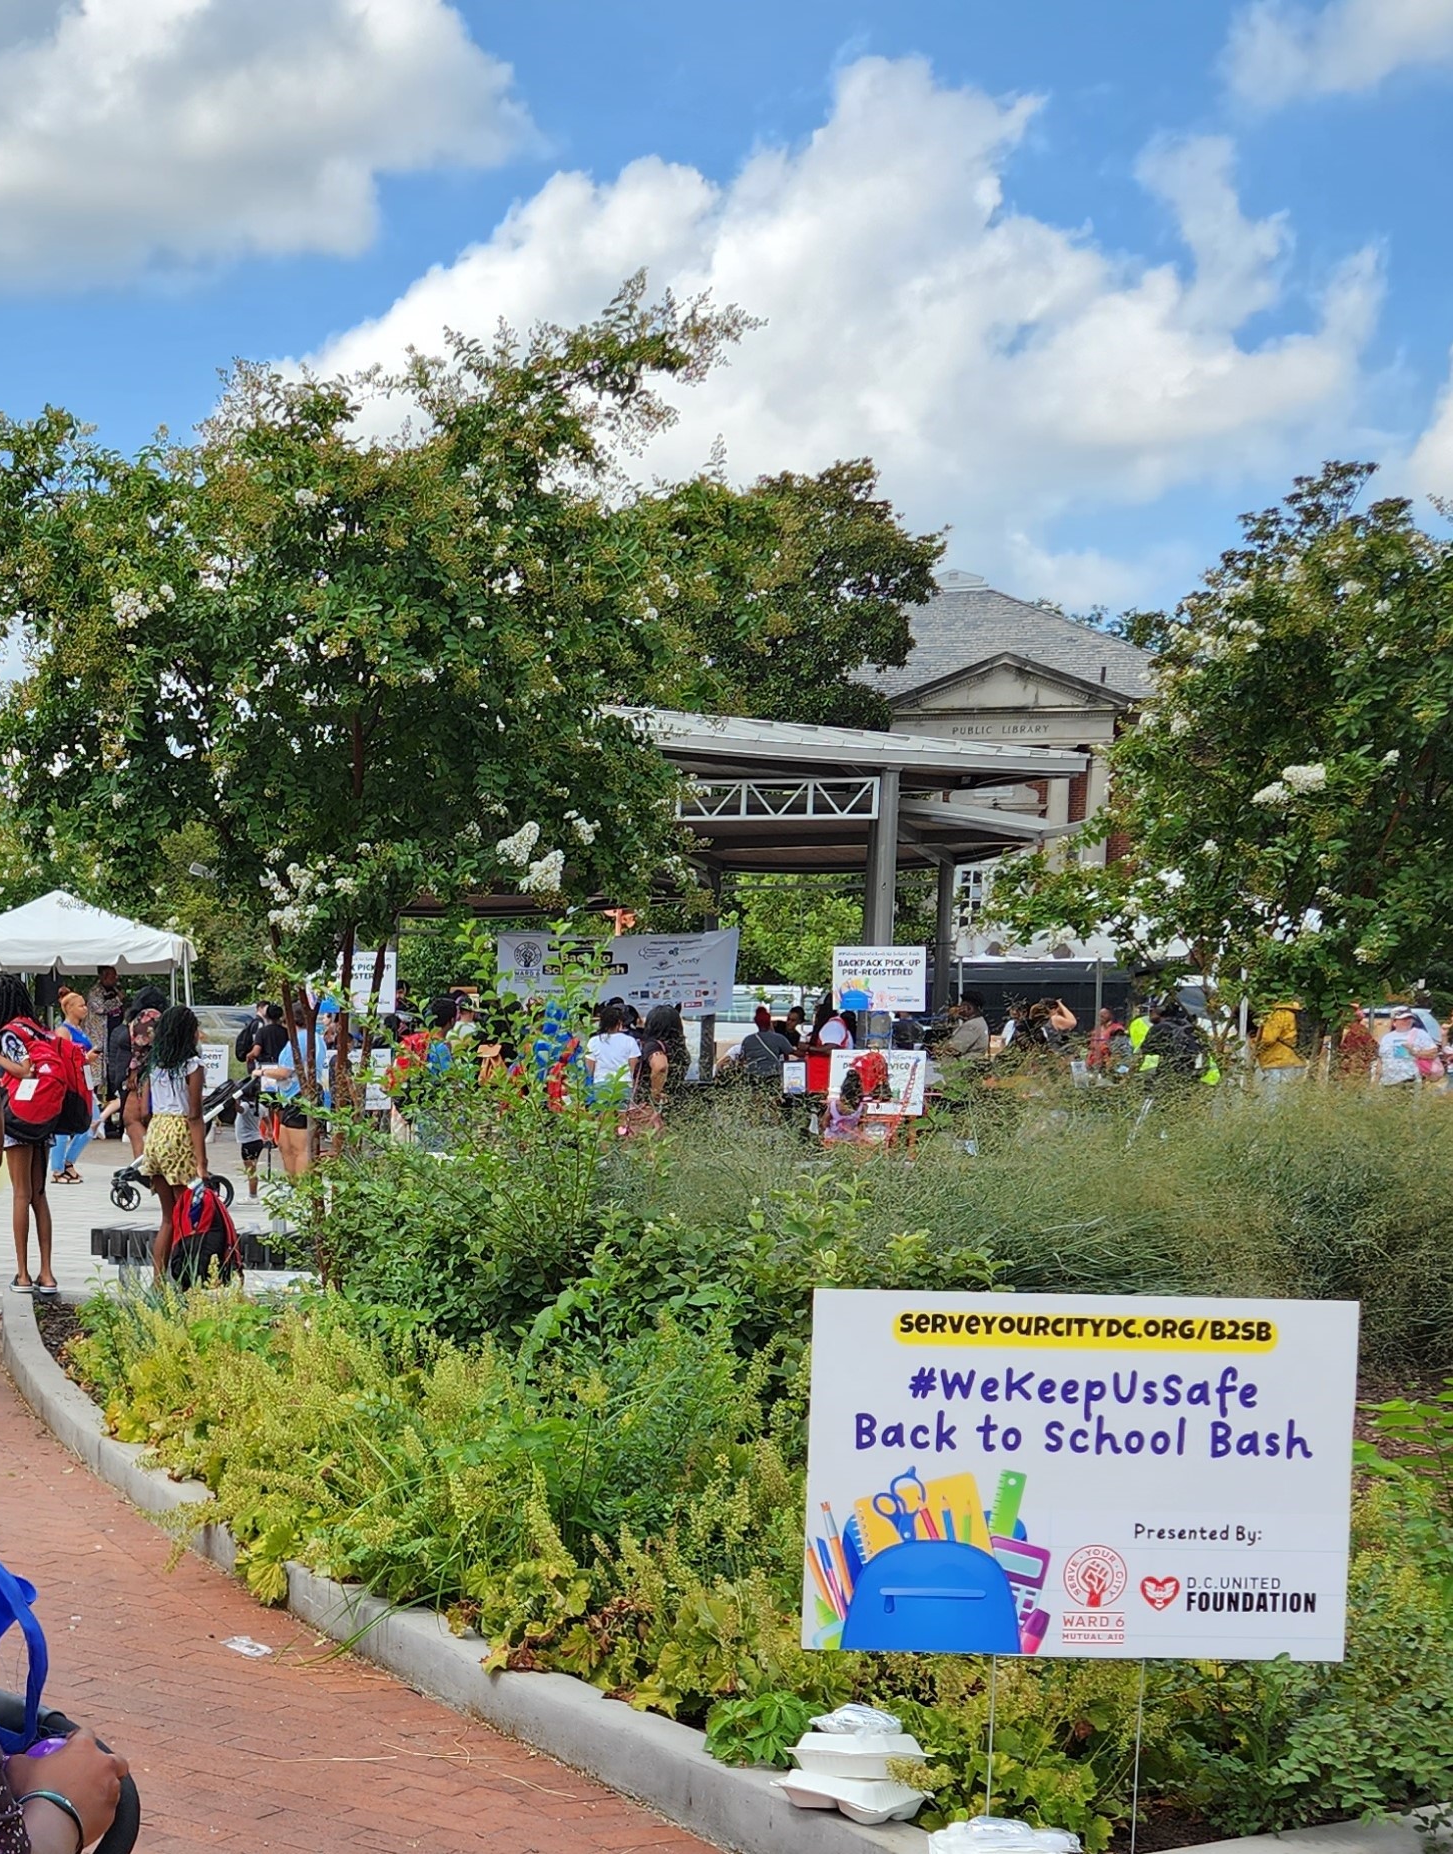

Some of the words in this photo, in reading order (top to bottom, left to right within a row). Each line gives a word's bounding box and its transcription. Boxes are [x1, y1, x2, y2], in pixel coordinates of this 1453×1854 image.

[952, 726, 993, 735] PUBLIC
[1001, 725, 1050, 734] LIBRARY
[838, 959, 883, 967] BACKPACK
[885, 959, 921, 967] PICK-UP
[842, 968, 913, 976] PRE-REGISTERED
[908, 1366, 1259, 1422] #WeKeepUsSafe
[855, 1410, 957, 1452] Back
[976, 1414, 1023, 1453] to
[1044, 1414, 1187, 1456] School
[1210, 1419, 1314, 1460] Bash
[1134, 1523, 1229, 1542] Presented
[1235, 1525, 1263, 1547] By:
[1085, 1548, 1117, 1564] YOUR
[1067, 1560, 1082, 1597] SERVE
[1109, 1570, 1124, 1598] CITY
[1186, 1591, 1317, 1613] FOUNDATION
[1062, 1615, 1109, 1628] WARD
[1115, 1615, 1125, 1628] 6
[1062, 1633, 1103, 1641] MUTUAL
[1107, 1633, 1125, 1641] AID
